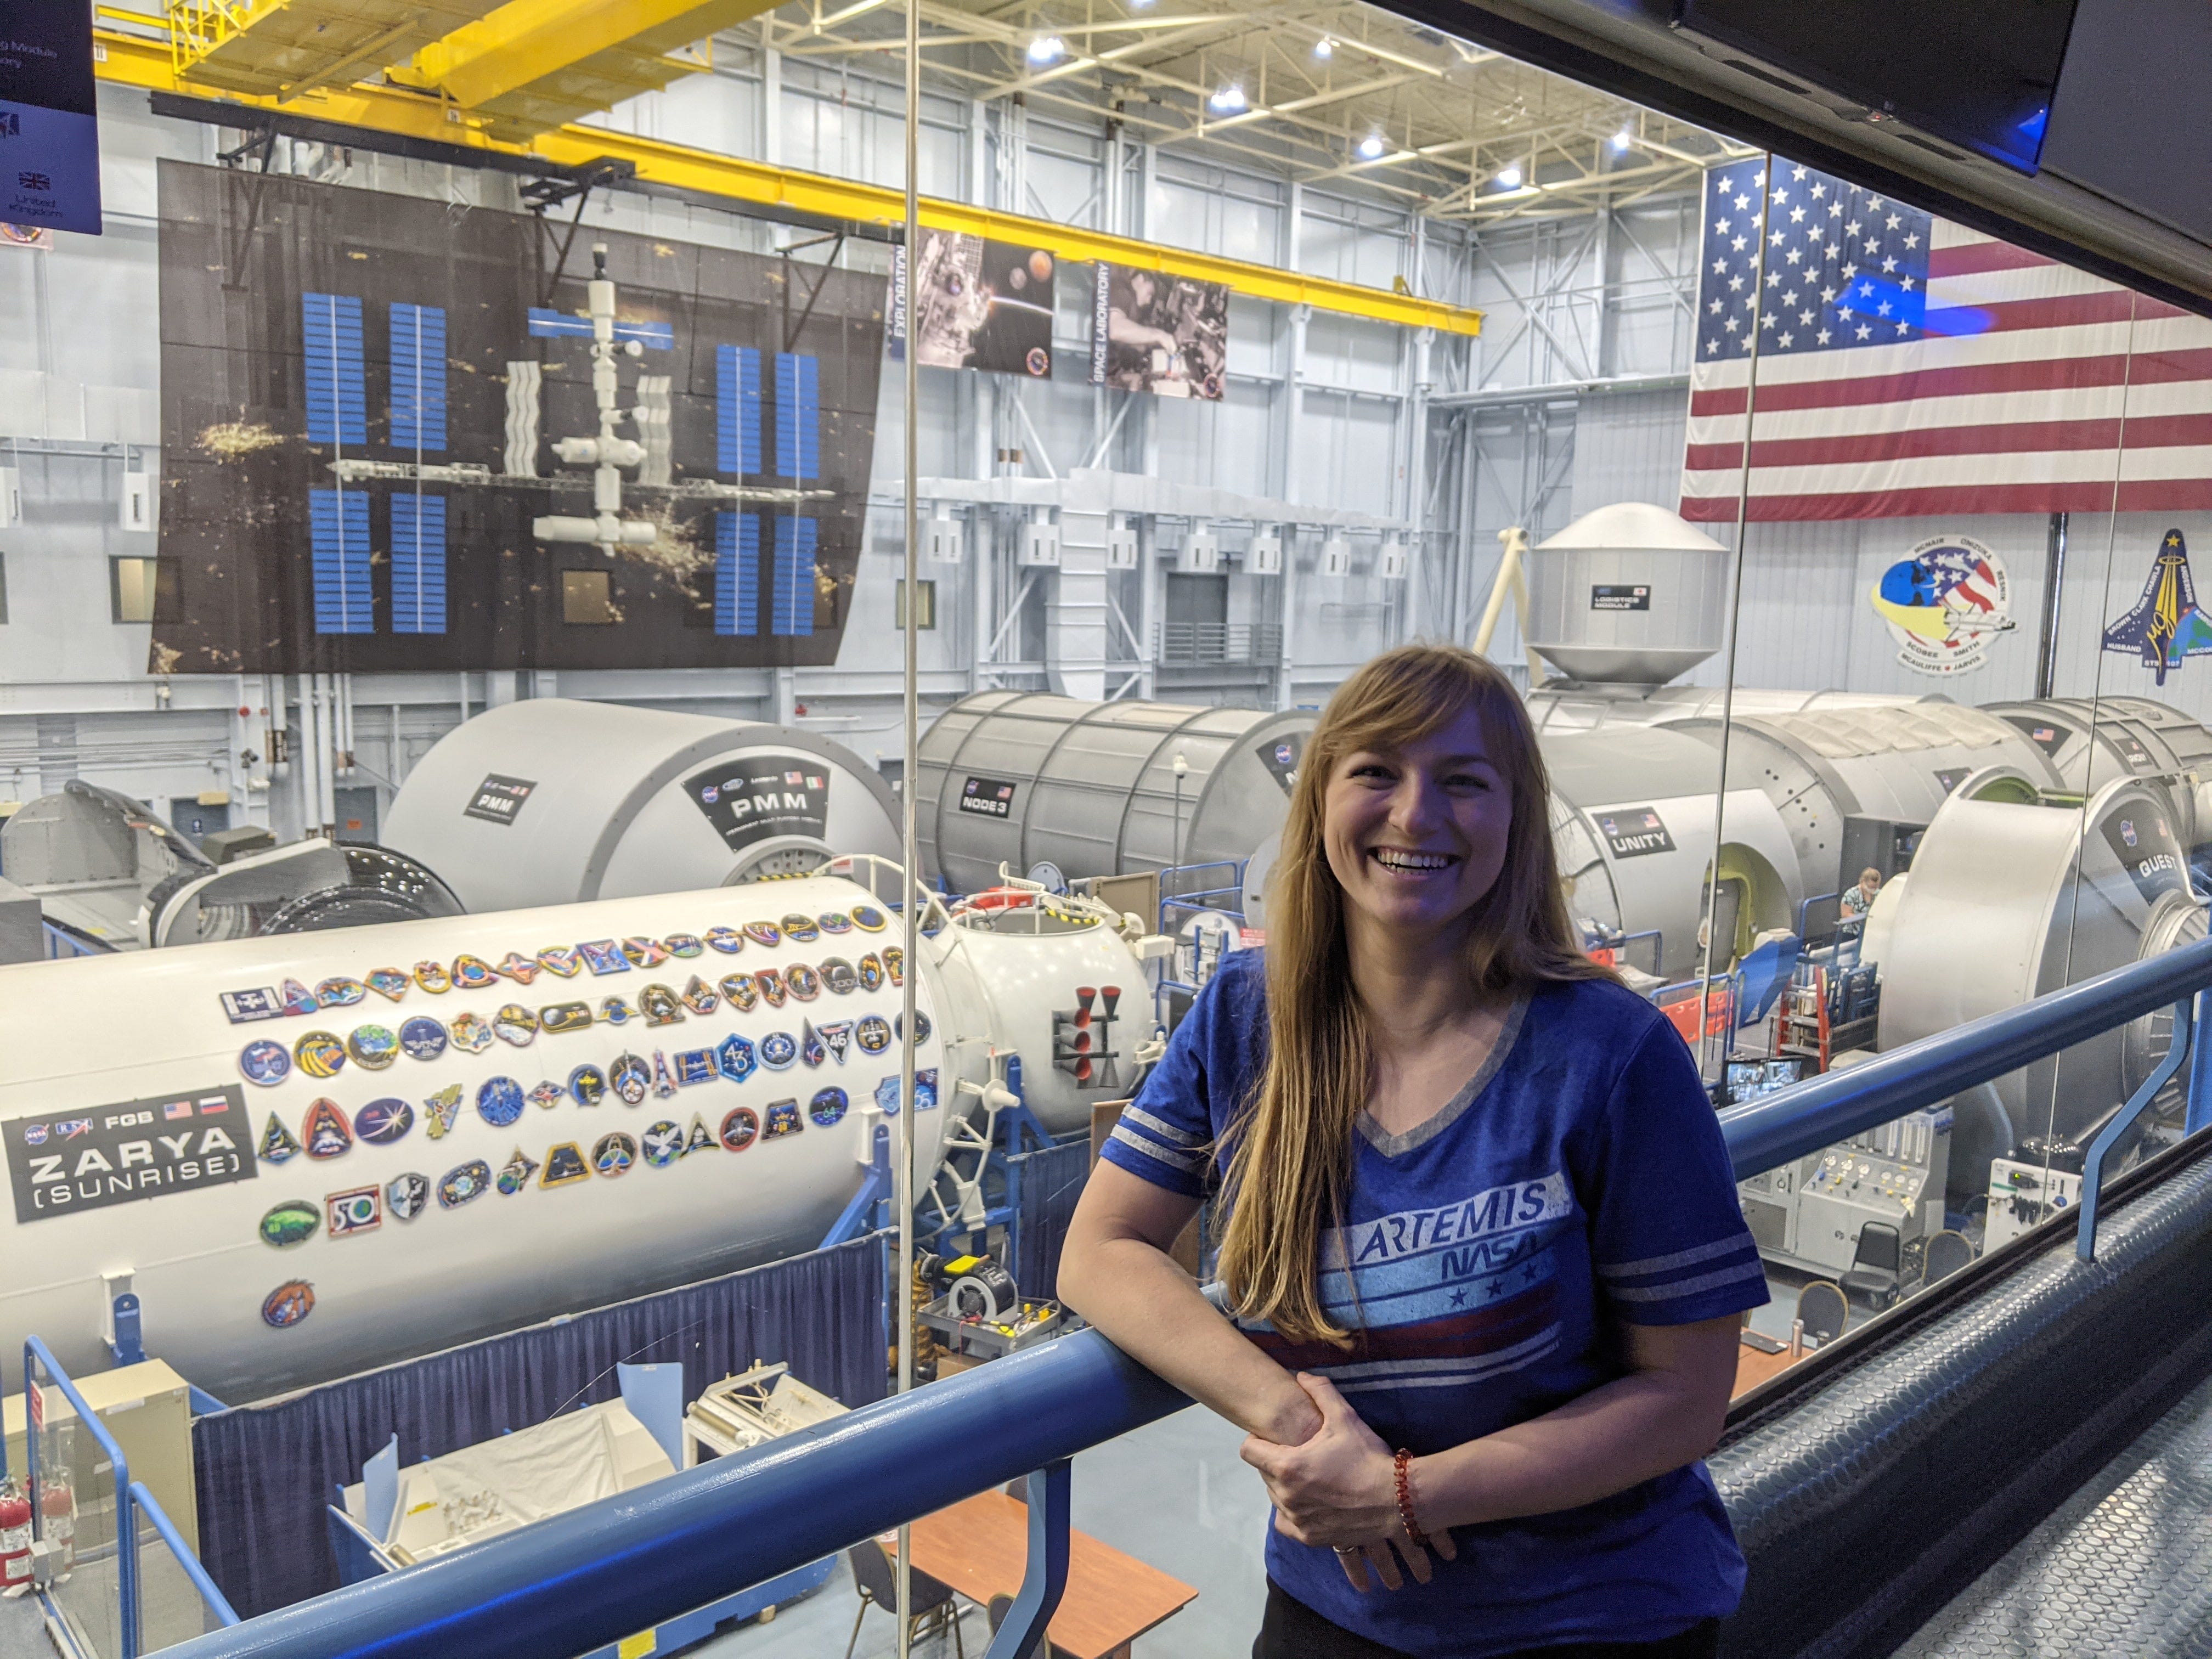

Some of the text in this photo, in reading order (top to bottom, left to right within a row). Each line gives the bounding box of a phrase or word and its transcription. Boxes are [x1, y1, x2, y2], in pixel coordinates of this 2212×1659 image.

[1093, 262, 1109, 383] SPACE LABORATORY
[1914, 537, 1993, 561] MCNAIR ONIZUKA
[1996, 569, 2006, 601] RESNIK
[2145, 565, 2162, 596] CHAWLA
[2131, 596, 2149, 617] CLARK
[2107, 616, 2132, 636] BROWN
[1905, 640, 1980, 658] SCOBEE SMITH
[2106, 642, 2142, 653] HUSBAND
[1900, 652, 1981, 672] MCAULIFFE JARVIS
[477, 794, 515, 813] PMM
[730, 792, 808, 819] PMM
[1612, 832, 1666, 853] UNITY
[2138, 854, 2177, 878] QUEST
[829, 1032, 847, 1047] 46
[725, 1043, 748, 1073] 43
[105, 1110, 154, 1130] FGB
[29, 1126, 236, 1185] ZARYA
[33, 1153, 240, 1209] (SUNRISE)
[334, 1194, 375, 1231] 50
[1357, 1182, 1547, 1262] ARTEMIS
[1441, 1229, 1539, 1280] NASA
